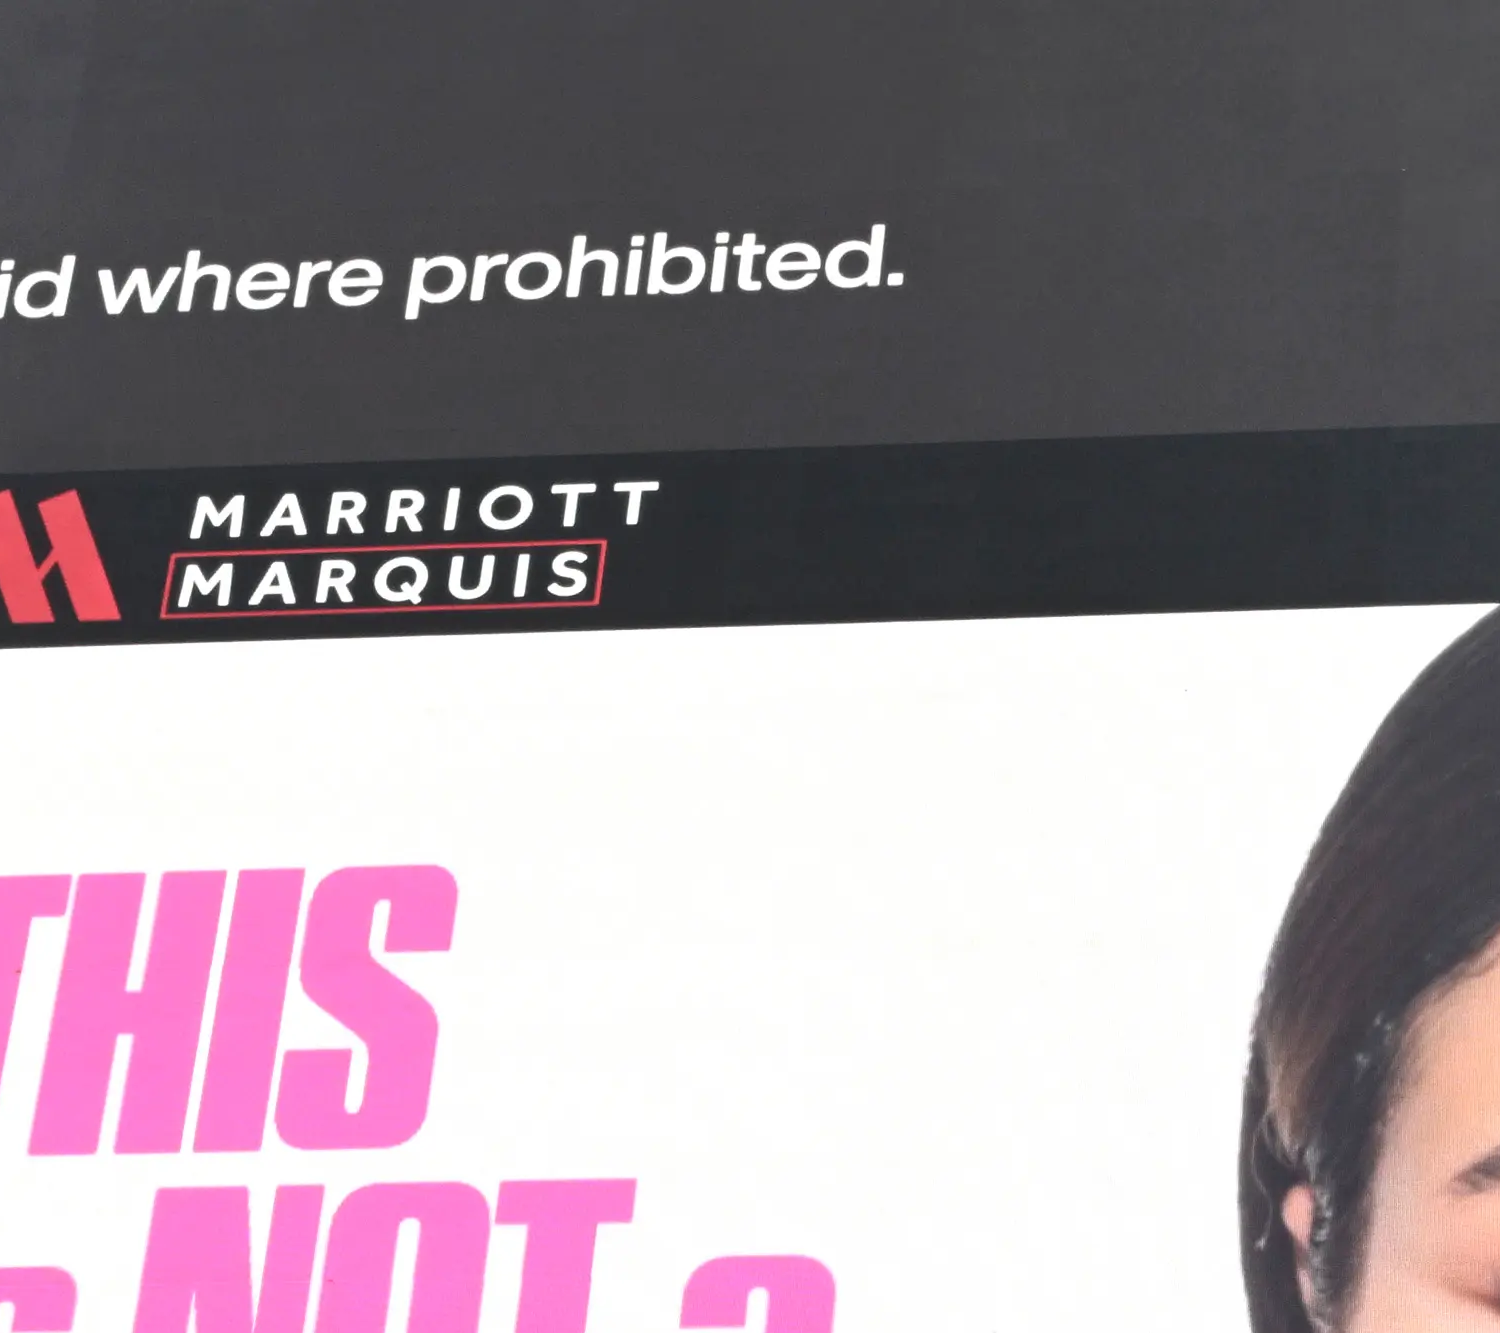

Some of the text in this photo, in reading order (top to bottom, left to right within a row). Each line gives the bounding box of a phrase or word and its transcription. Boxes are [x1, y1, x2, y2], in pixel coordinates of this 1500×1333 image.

[98, 249, 384, 315] where
[405, 223, 905, 321] prohibited.
[189, 480, 660, 540] MARRIOTT
[177, 550, 588, 608] MARQUIS
